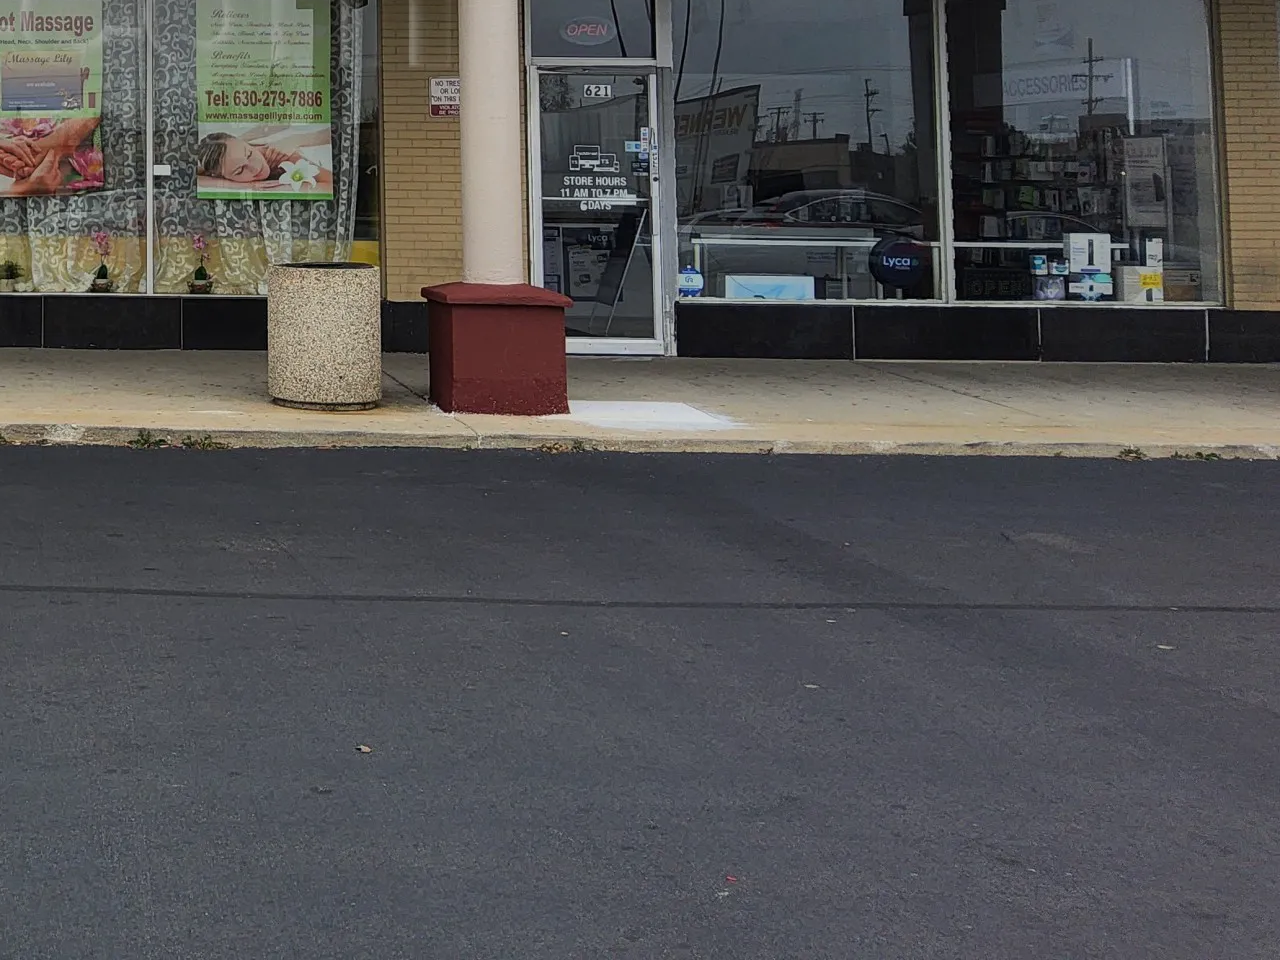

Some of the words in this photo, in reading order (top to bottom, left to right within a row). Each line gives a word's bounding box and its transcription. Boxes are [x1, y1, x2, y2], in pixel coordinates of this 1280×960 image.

[20, 11, 94, 37] Massage
[567, 24, 608, 36] OPEN
[7, 52, 49, 65] Massage
[53, 53, 73, 65] Lily
[584, 85, 610, 98] 621
[205, 90, 229, 107] Tel:
[233, 90, 323, 107] 630-279-7886
[563, 176, 594, 186] STORE
[595, 177, 627, 186] HOURS
[560, 188, 570, 197] 11
[573, 188, 589, 198] AM
[591, 188, 602, 198] TO
[613, 188, 628, 198] PM
[587, 233, 609, 243] Lyca
[882, 256, 911, 267] Lyca
